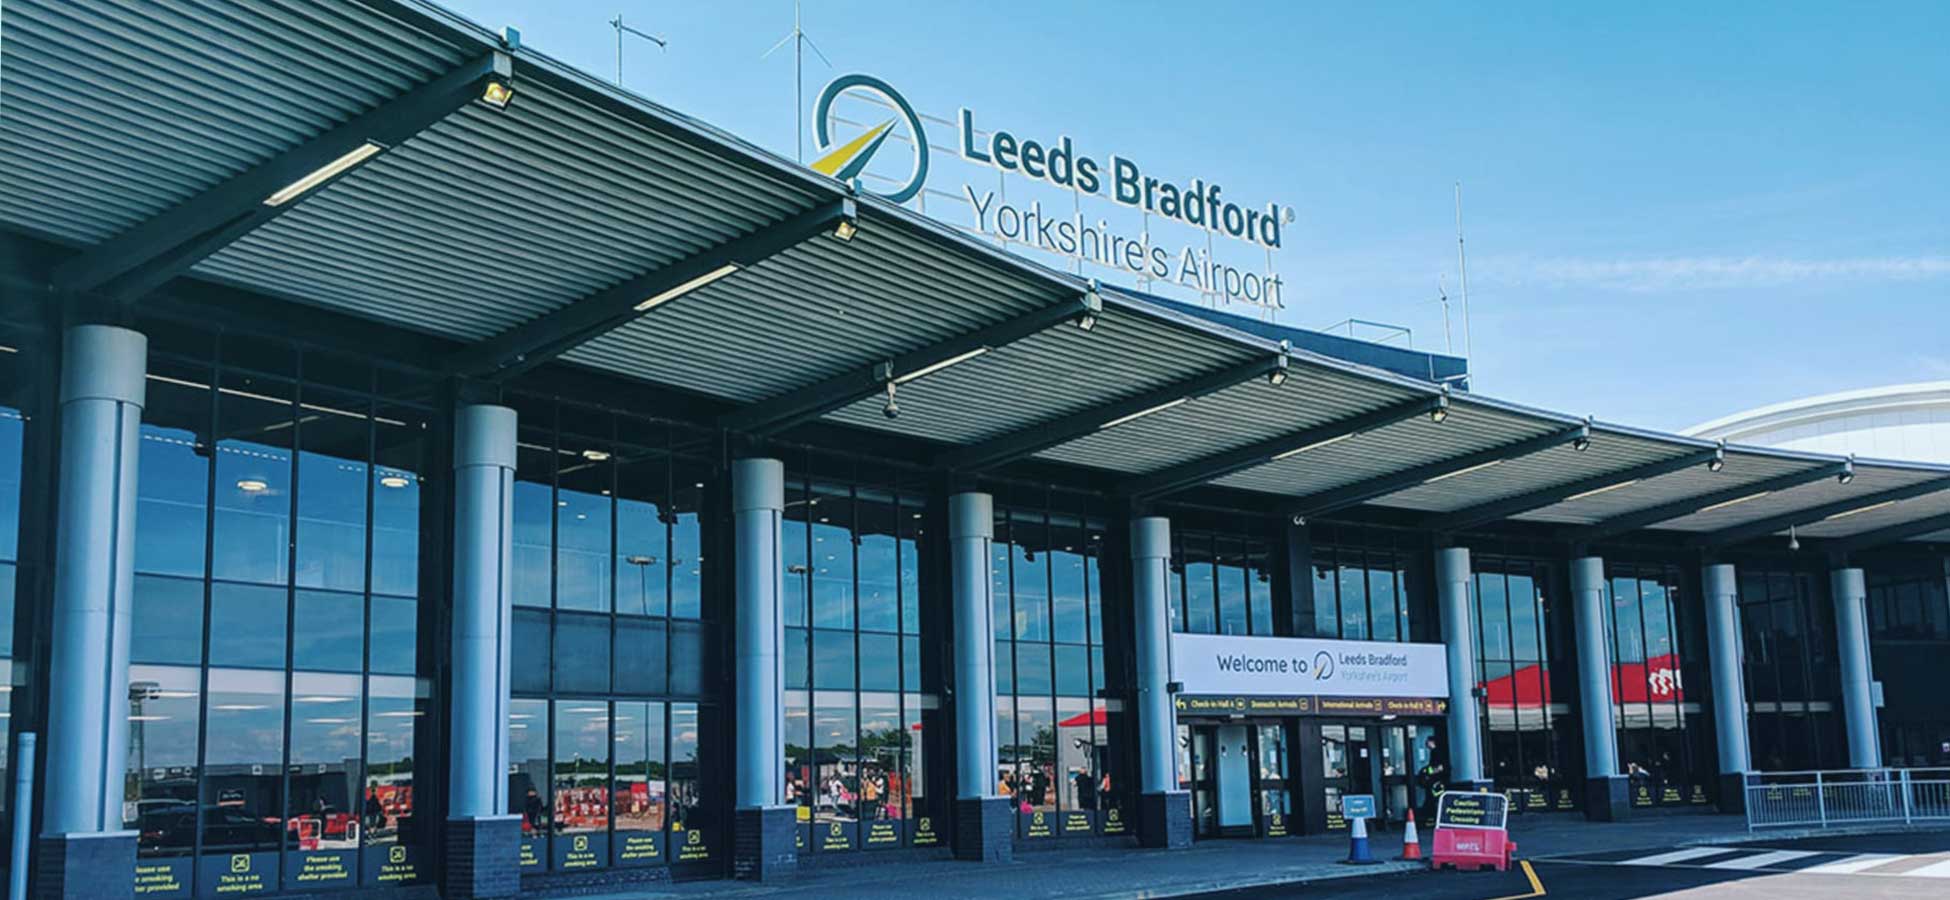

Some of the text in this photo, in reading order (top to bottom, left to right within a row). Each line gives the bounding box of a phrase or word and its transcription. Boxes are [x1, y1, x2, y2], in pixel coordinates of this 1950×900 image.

[960, 108, 1281, 248] Leeds Bradford
[963, 184, 1285, 309] Yorkshire's Airport
[1216, 654, 1308, 673] Welcome to
[1339, 652, 1408, 666] Leeds Bradford
[1453, 799, 1479, 807] Caution
[1450, 815, 1479, 824] Crossing
[140, 875, 173, 883] smoking
[221, 875, 236, 883] This
[378, 873, 403, 881] smoking
[217, 883, 247, 892] smoking
